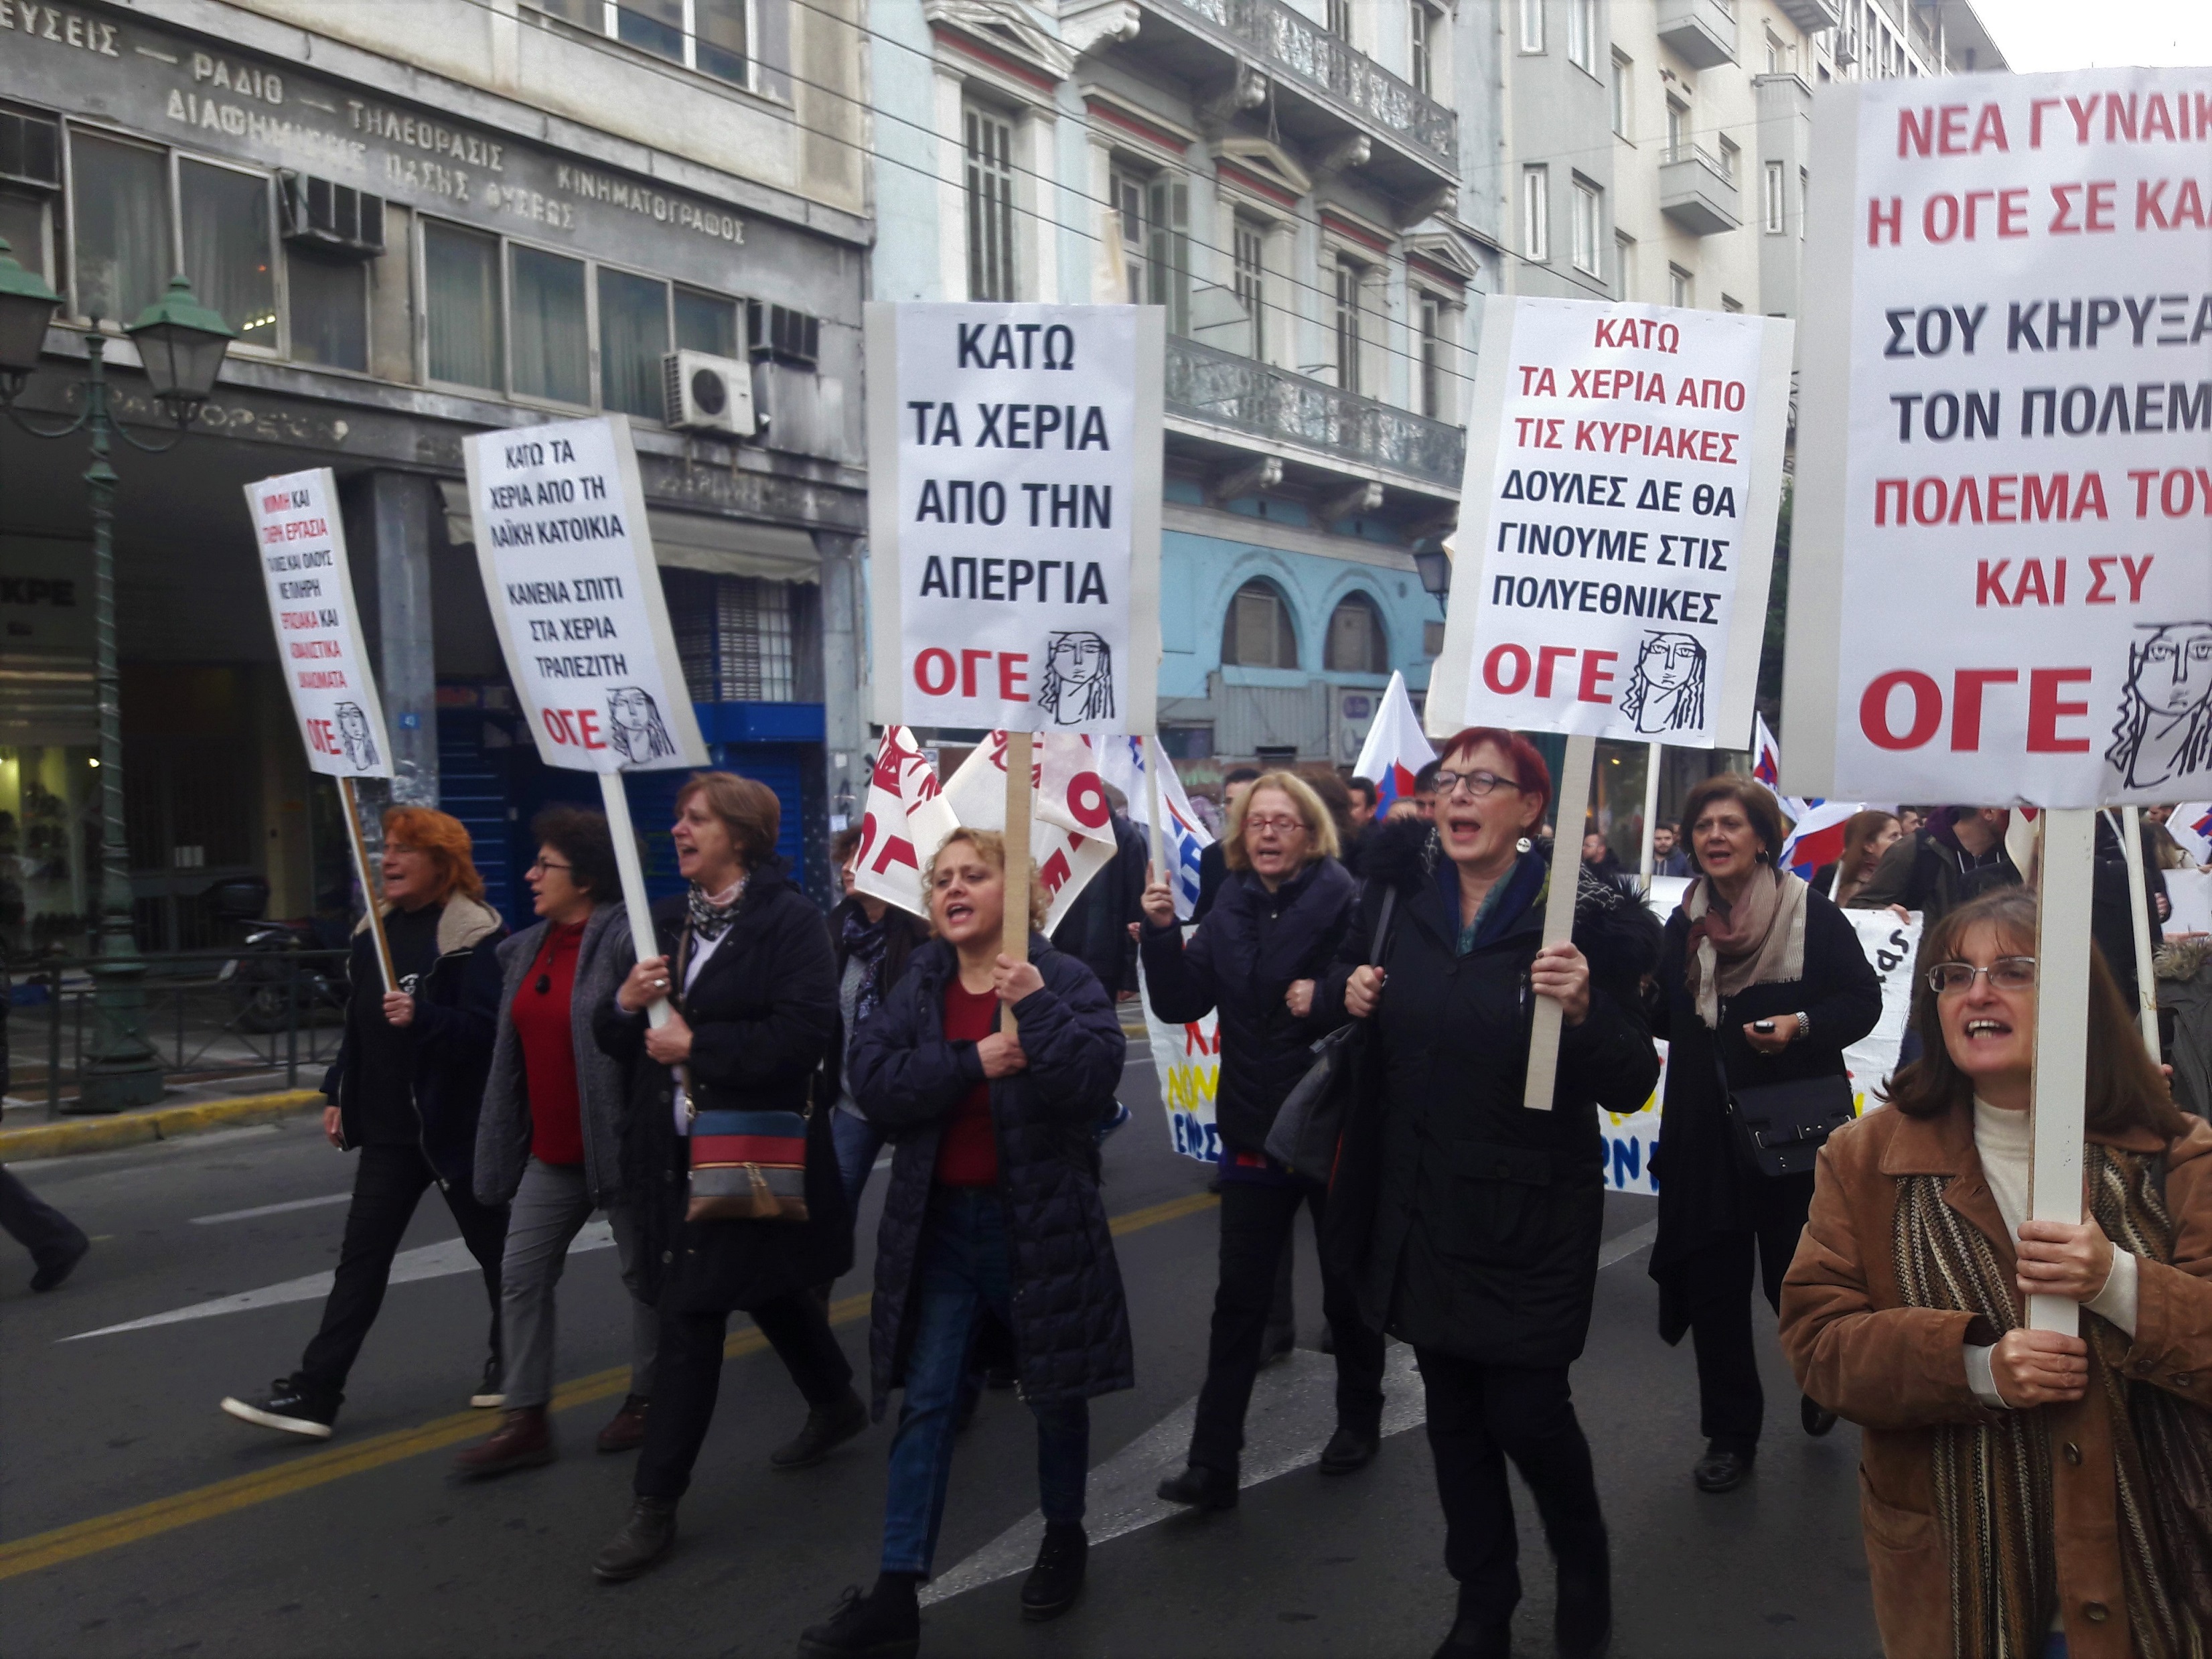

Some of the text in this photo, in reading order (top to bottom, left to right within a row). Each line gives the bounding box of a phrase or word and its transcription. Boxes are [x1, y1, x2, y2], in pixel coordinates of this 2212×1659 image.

[193, 52, 283, 104] ΡΑΔΙΟ
[348, 100, 503, 171] ΤΗΛΕΟΡΑΣΙΣ
[557, 164, 745, 245] ΚΙΝΗΜΑΤΟΓΡΑΦΟΣ
[1897, 102, 2010, 159] ΝΕΑ
[1866, 196, 1902, 247] Η
[1922, 187, 2029, 244] ΟΓΕ
[2048, 180, 2117, 236] ΣΕ
[957, 323, 1075, 370] ΚΑΤΩ
[1594, 317, 1680, 356] ΚΑΤΩ
[1883, 301, 1988, 360] ΣΟΥ
[1518, 365, 1747, 413] ΤΑ ΧΕΡΙΑ ΑΠΟ
[907, 401, 1110, 451] ΤΑ ΧΕΡΙΑ
[1514, 417, 1741, 465] ΤΙΣ ΚΥΡΙΑΚΕΣ
[1889, 387, 2001, 445] ΤΟΝ
[504, 438, 577, 471] ΚΑΤΩ ΤΑ
[489, 474, 607, 510] ΧΕΡΙΑ ΑΠΟ ΤΗ
[915, 479, 1112, 529] ΑΠΟ ΤΗΝ
[1500, 468, 1737, 518] ΔΟΥΛΕΣ ΔΕ ΘΑ
[1874, 471, 2109, 528] ΠΟΛΕΜΑ
[536, 513, 625, 545] ΚΑΤΟΙΚΙΑ
[1496, 521, 1730, 572] ΓΙΝΟΥΜΕ ΣΤΙΣ
[506, 575, 624, 606] ΚΑΝΕΝΑ ΣΠΙΤΙ
[919, 555, 1109, 605] ΑΠΕΡΓΙΑ
[1491, 574, 1722, 625] ΠΟΛΥΕΘΝΙΚΕΣ
[1976, 554, 2155, 609] ΚΑΙ ΣΥ
[528, 614, 617, 642] ΣΤΑ ΧΕΡΙΑ
[535, 652, 629, 678] ΤΡΑΠΕΖΙΤΗ
[913, 647, 1031, 703] ΟΓΕ
[1482, 642, 1619, 705] ΟΓΕ
[542, 707, 607, 750] ΟΓΕ
[1859, 666, 2093, 754] ΟΓΕ
